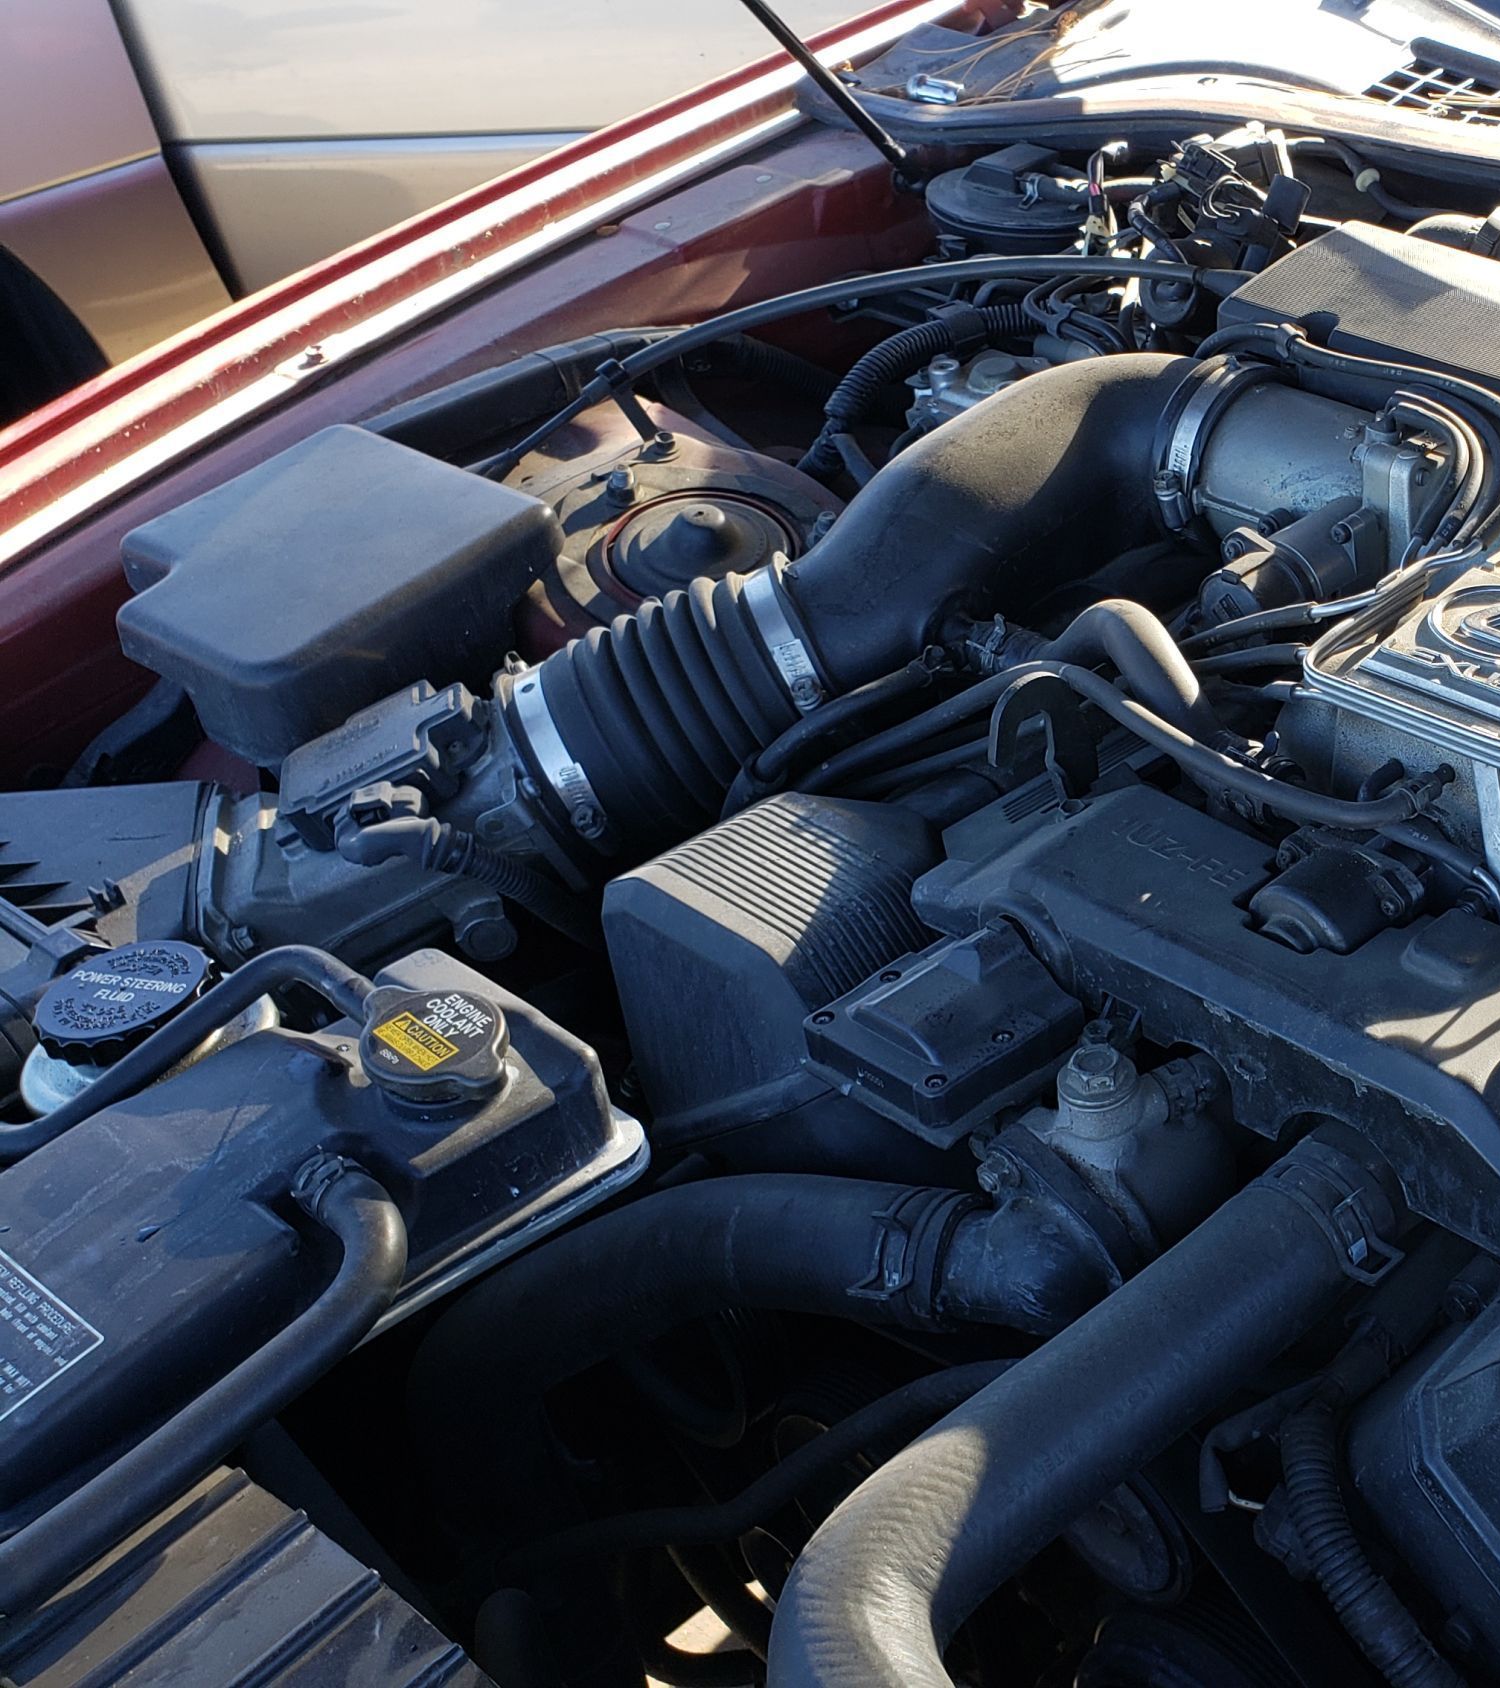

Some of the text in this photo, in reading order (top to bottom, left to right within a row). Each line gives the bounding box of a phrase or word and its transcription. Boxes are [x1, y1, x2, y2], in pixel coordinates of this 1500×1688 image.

[71, 970, 188, 994] POWER STEERING
[93, 988, 135, 1002] FLUID
[423, 1014, 460, 1038] ONLY
[426, 998, 485, 1038] COOLANT
[444, 993, 493, 1028] ENGINE
[406, 1024, 451, 1057] CAUTION
[9, 1276, 41, 1306] REFILLING
[37, 1301, 76, 1336] PROCEDURE
